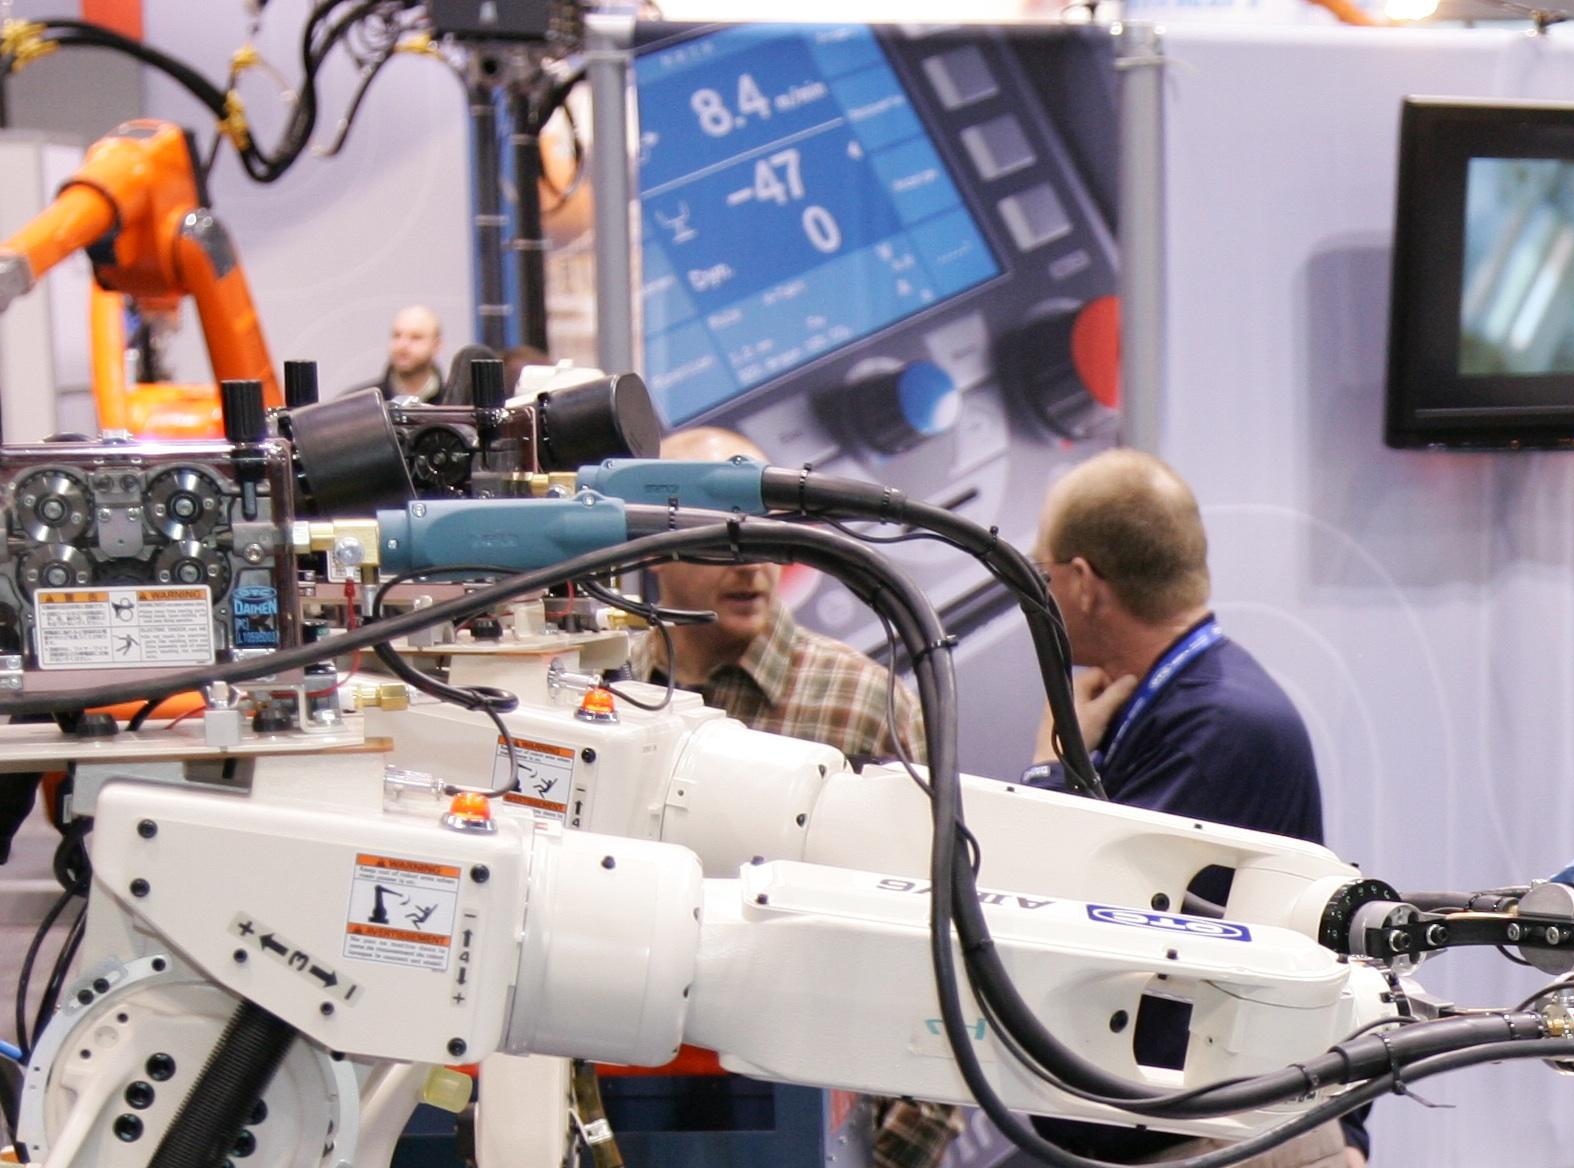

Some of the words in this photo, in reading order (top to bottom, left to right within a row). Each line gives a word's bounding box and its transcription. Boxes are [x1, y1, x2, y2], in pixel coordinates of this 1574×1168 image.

[690, 73, 771, 138] 8.4
[1111, 911, 1227, 936] OTC
[288, 950, 309, 971] 3
[459, 951, 470, 963] 4
